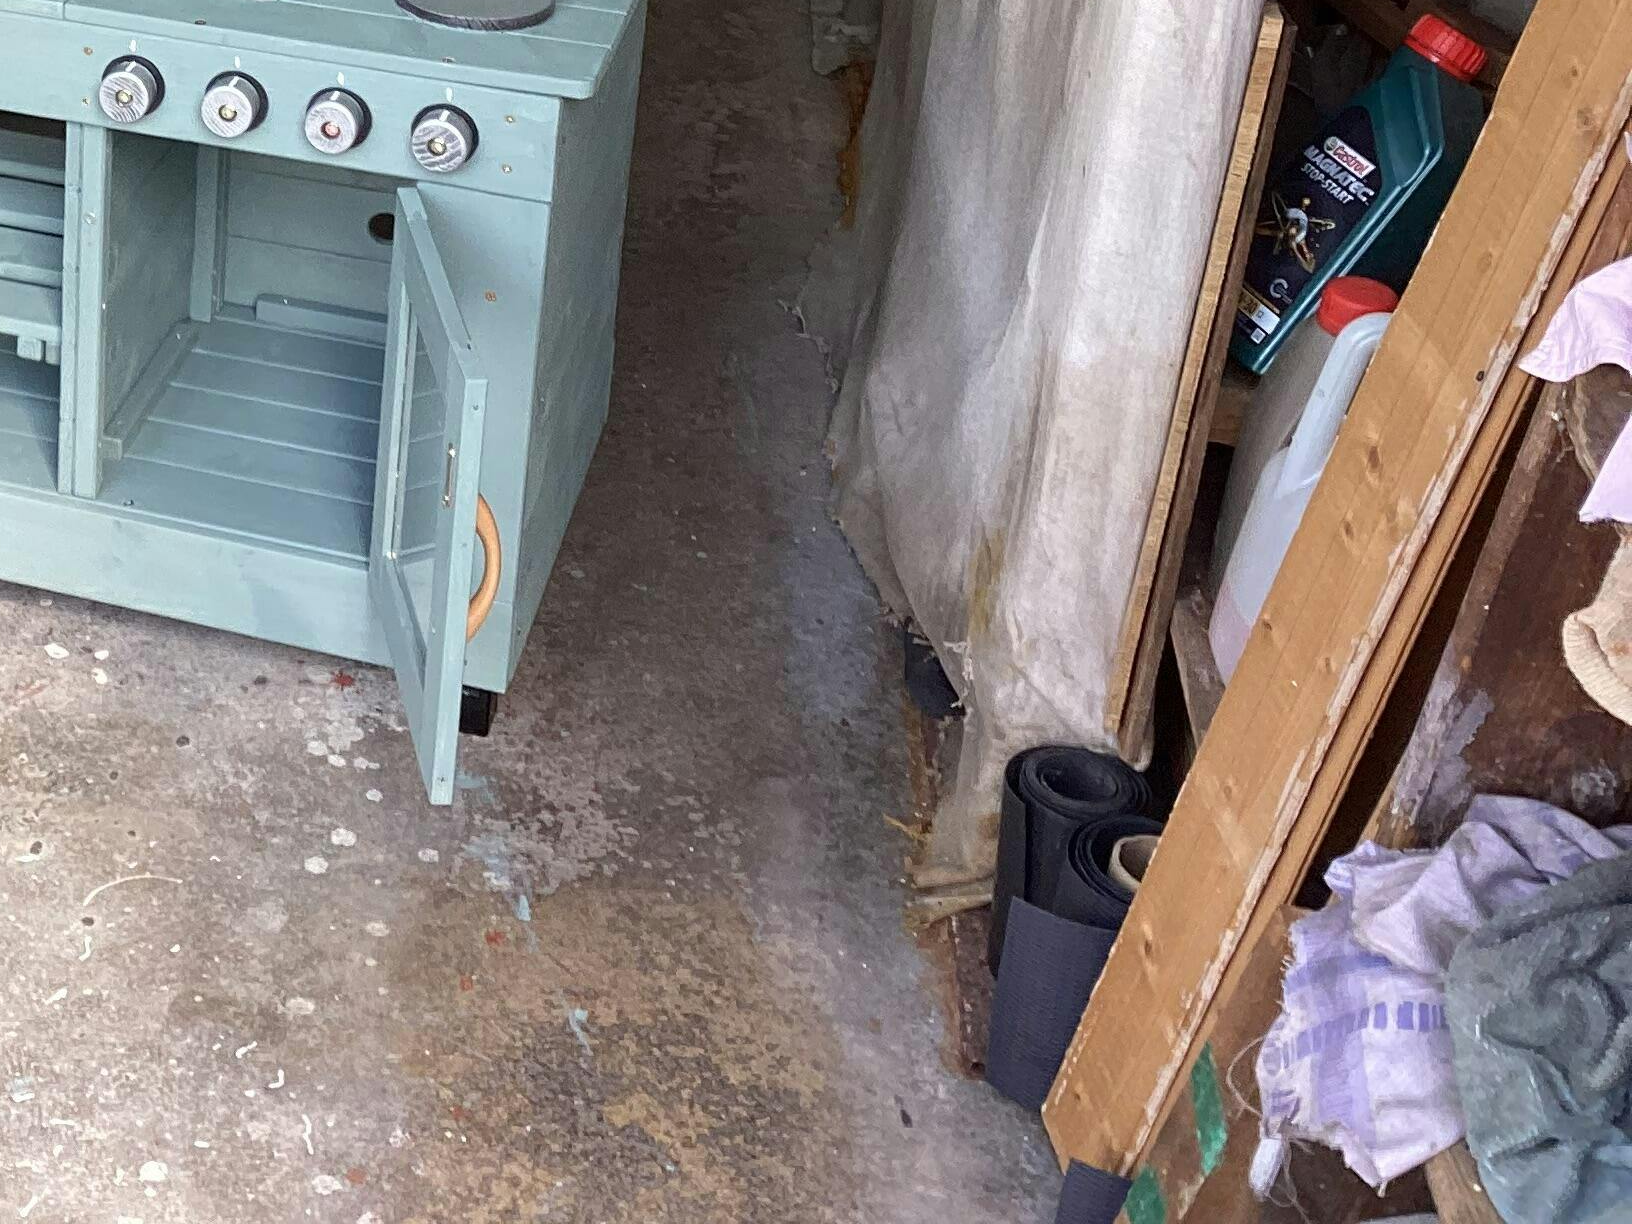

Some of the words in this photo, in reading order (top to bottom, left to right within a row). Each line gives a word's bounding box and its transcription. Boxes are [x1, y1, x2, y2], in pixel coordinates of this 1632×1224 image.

[1303, 144, 1375, 203] MAGNATEC
[1333, 145, 1369, 176] Castrol
[1300, 162, 1355, 205] STOP-START
